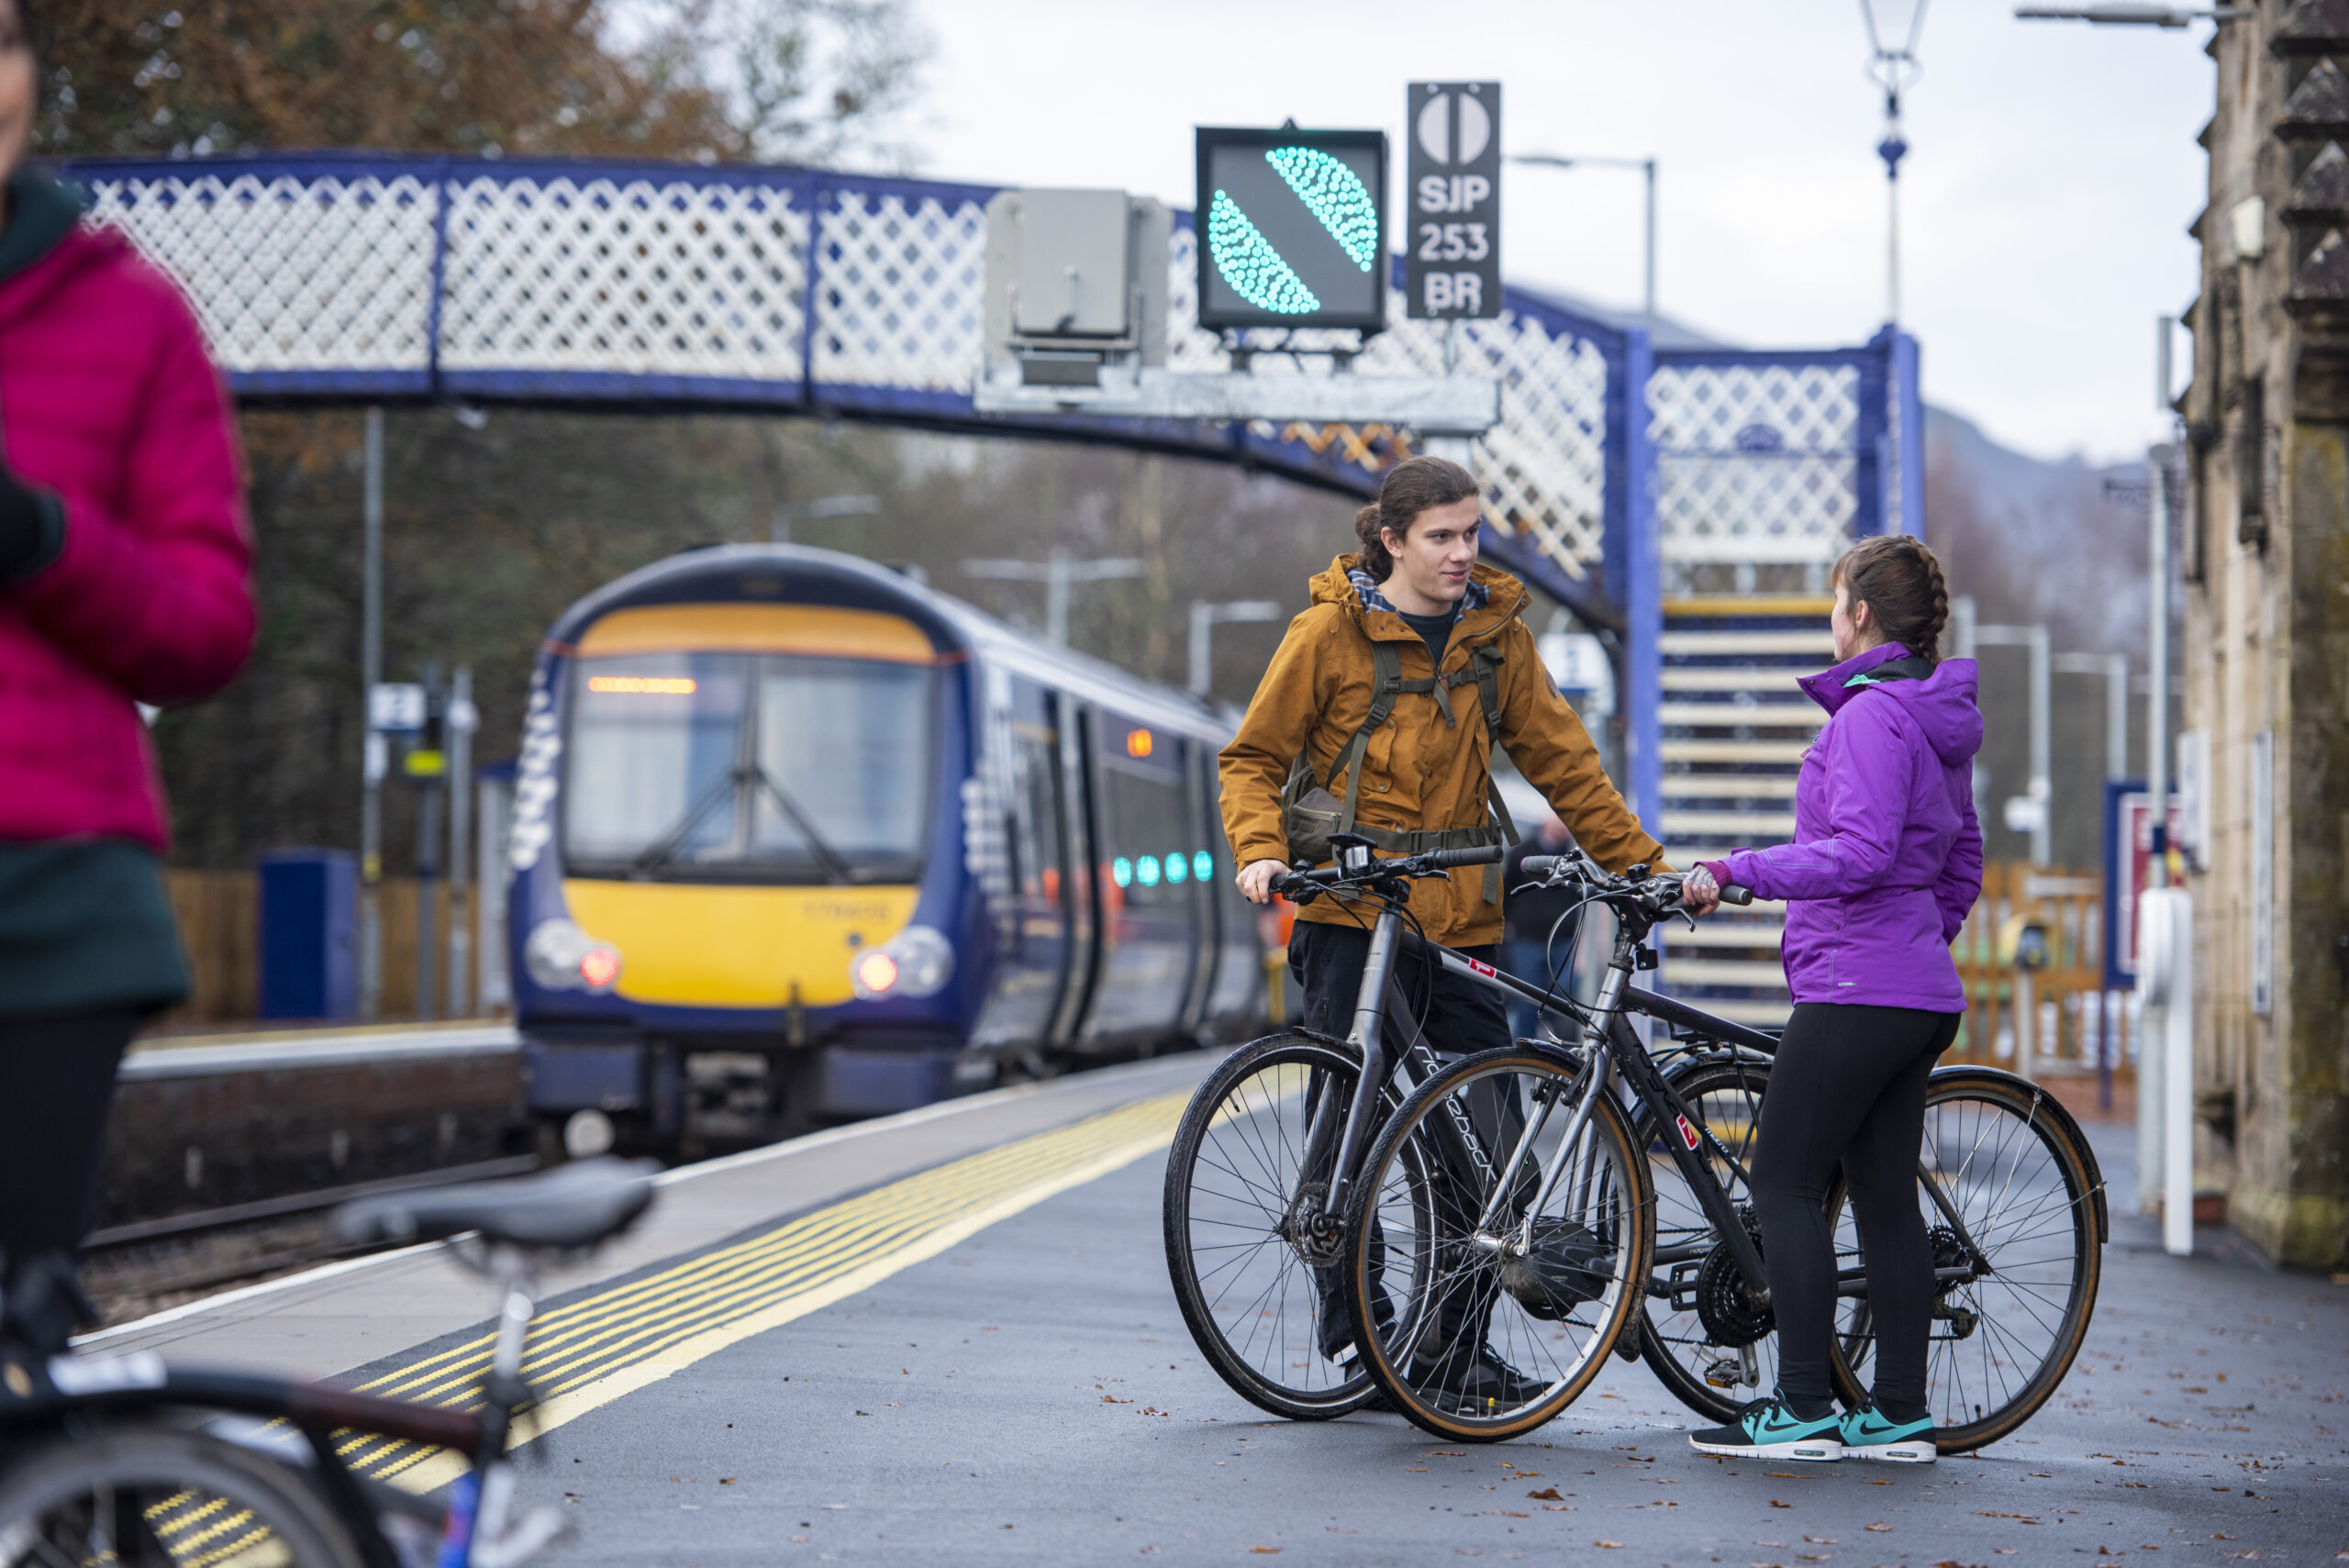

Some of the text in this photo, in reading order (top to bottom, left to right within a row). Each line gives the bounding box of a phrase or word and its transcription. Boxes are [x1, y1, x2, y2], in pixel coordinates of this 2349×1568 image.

[1418, 175, 1490, 213] SJP
[1419, 223, 1489, 261] 253
[1424, 272, 1482, 309] BR
[1414, 1045, 1498, 1182] rieback
